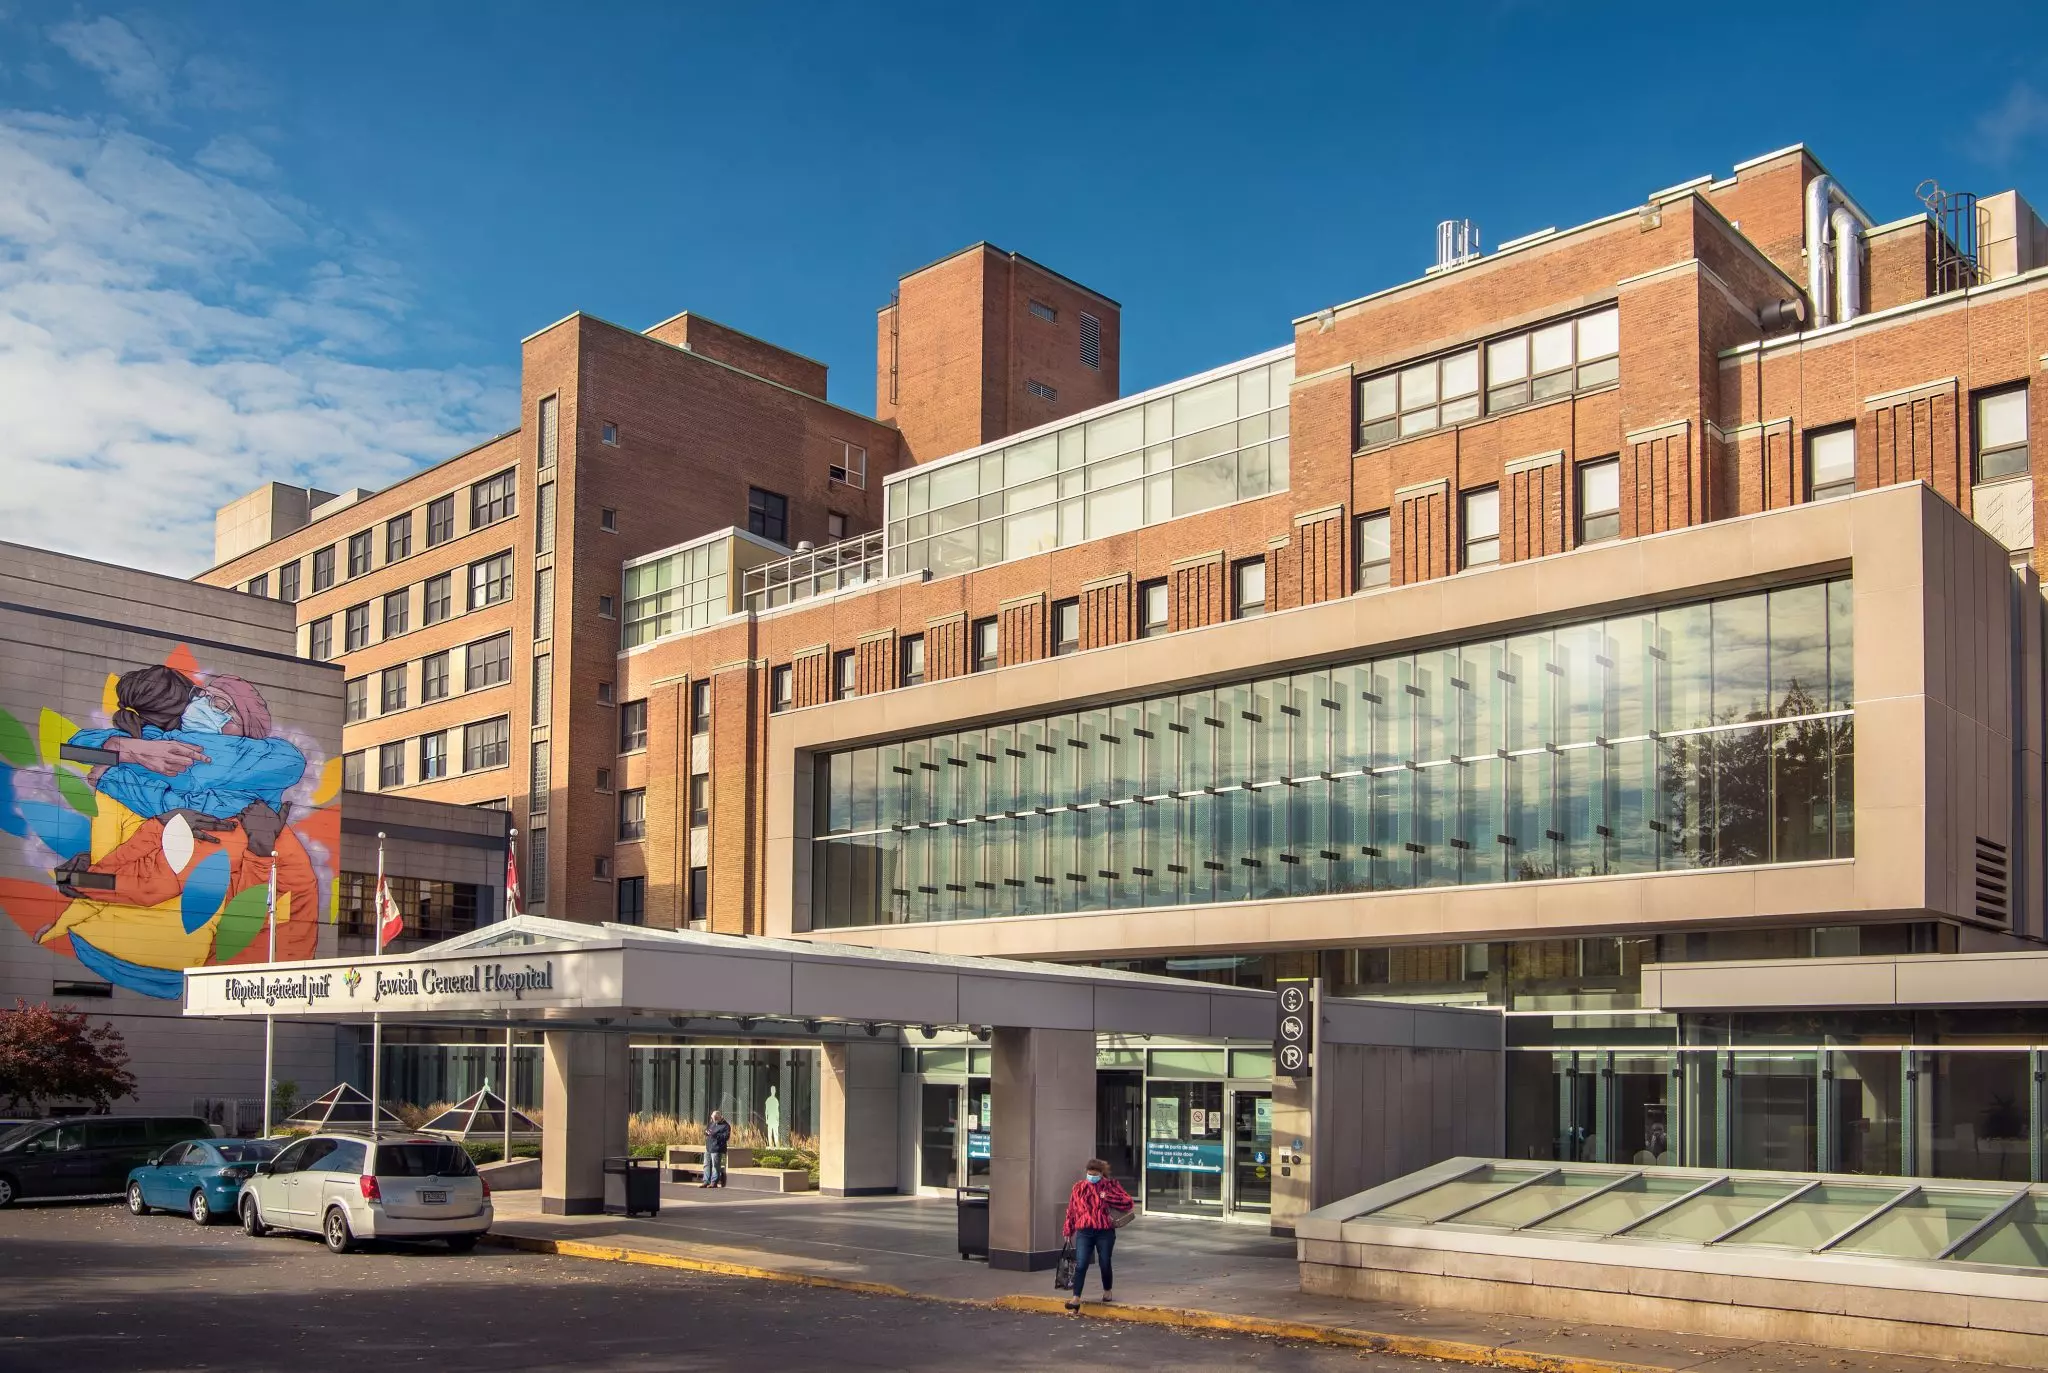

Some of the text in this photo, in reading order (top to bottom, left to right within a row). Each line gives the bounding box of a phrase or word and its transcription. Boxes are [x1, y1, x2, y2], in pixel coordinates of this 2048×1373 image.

[225, 973, 332, 1007] Hôpital général juif
[374, 960, 552, 1002] Jewish General Hospital
